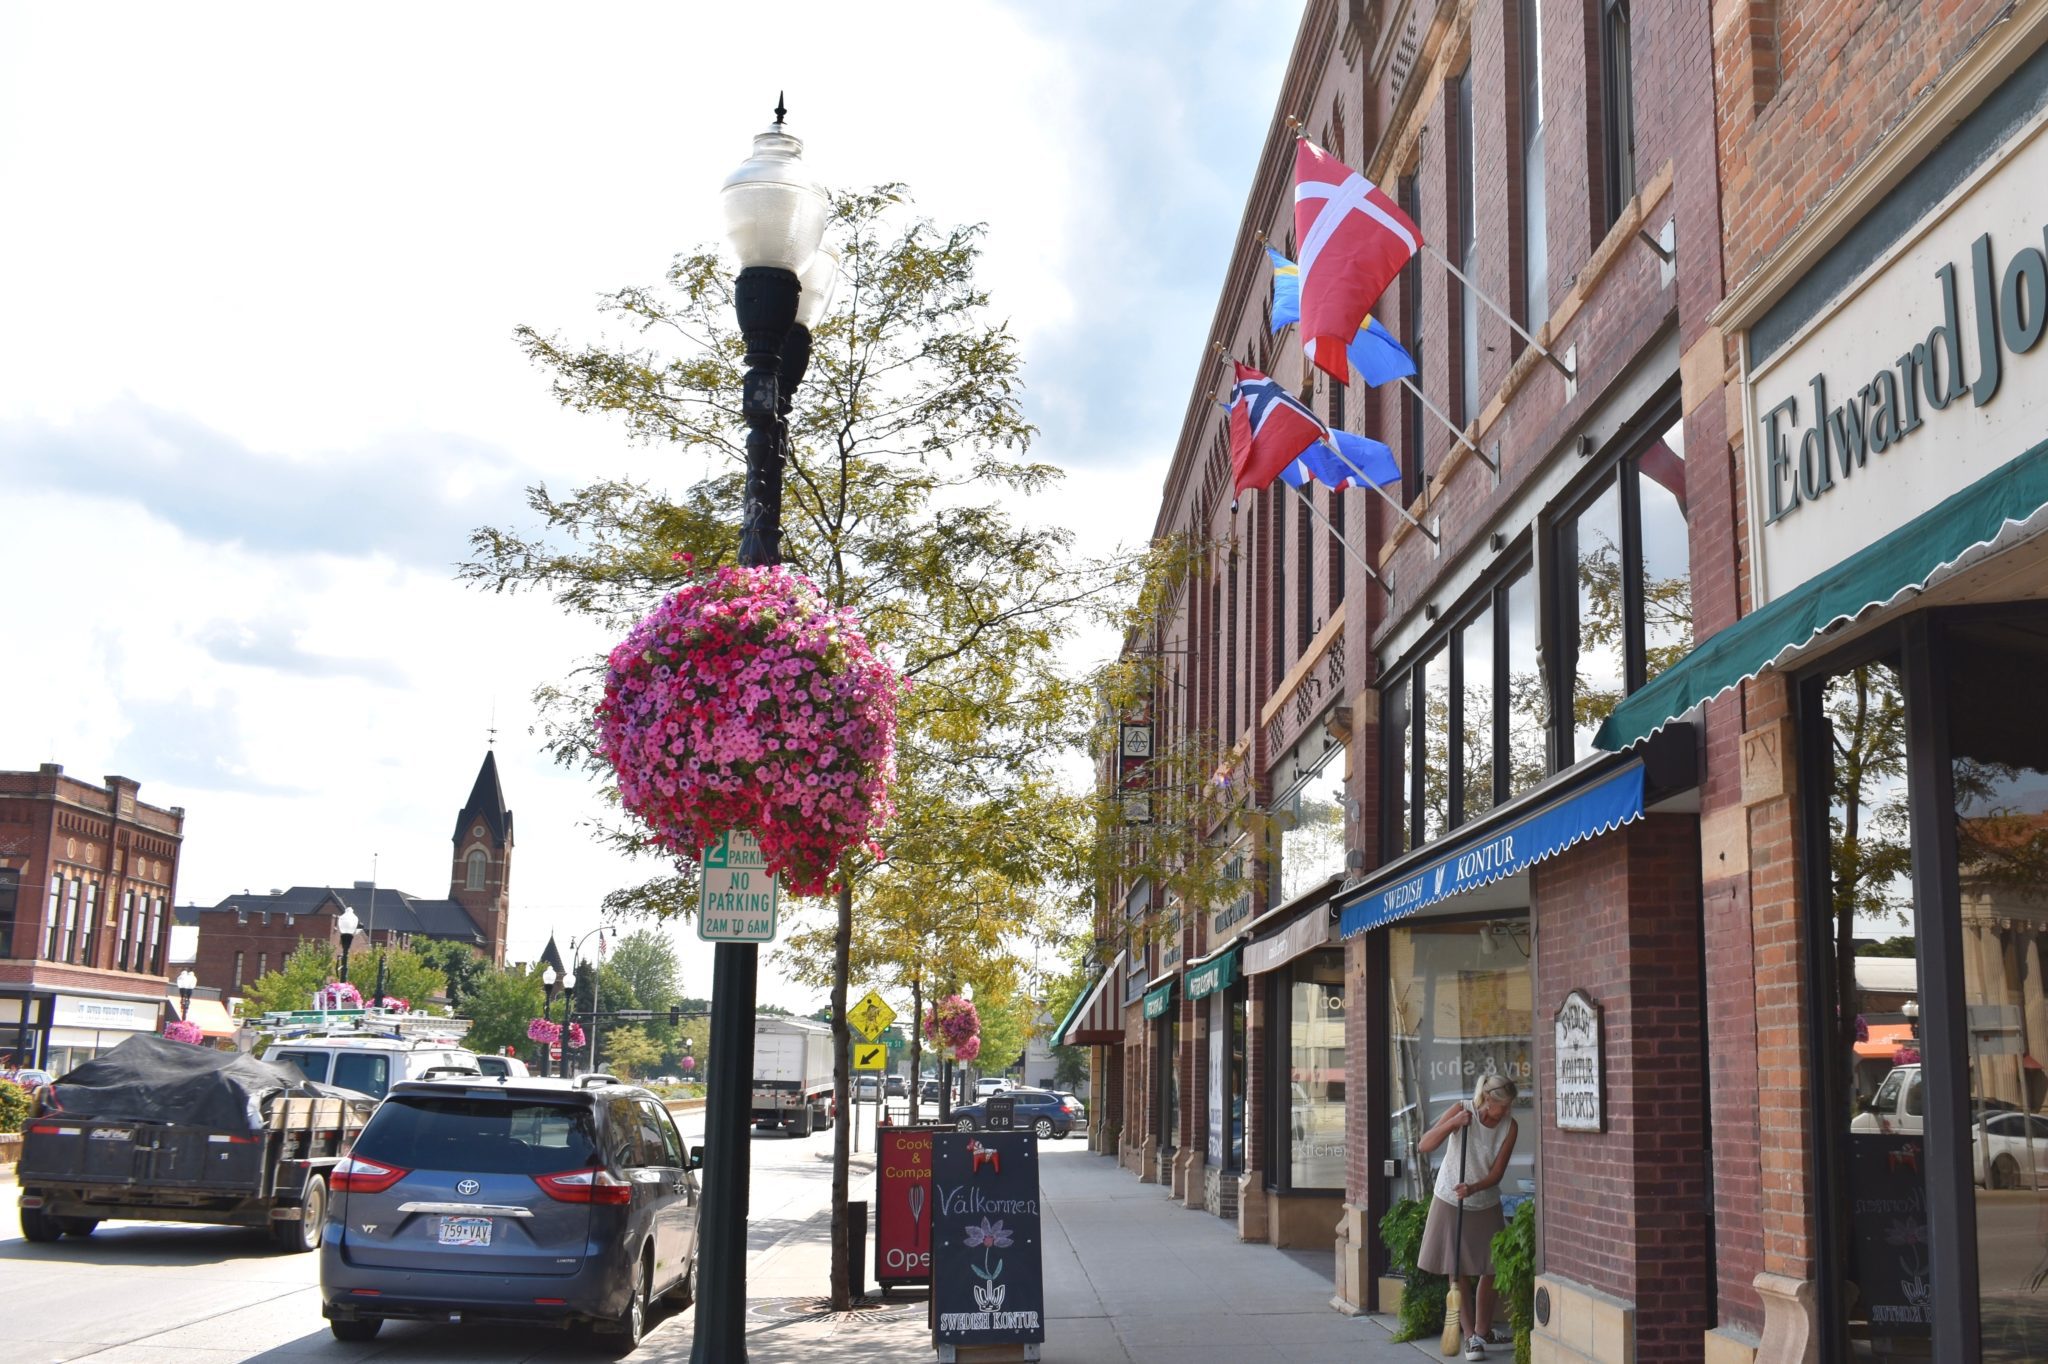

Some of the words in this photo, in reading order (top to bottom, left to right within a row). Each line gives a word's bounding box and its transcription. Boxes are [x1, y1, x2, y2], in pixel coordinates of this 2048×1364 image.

[1761, 224, 2048, 527] EdwardJo
[731, 872, 750, 890] NO
[1383, 877, 1424, 913] SWEDISH
[1456, 835, 1515, 882] KONTUR
[708, 892, 769, 912] PARKING
[706, 918, 728, 933] 2AM
[732, 918, 744, 933] TO
[747, 919, 769, 934] 6AM
[1561, 1005, 1591, 1041] SWEDISH
[1561, 1058, 1594, 1085] KONTUR
[1560, 1092, 1594, 1119] IMPORTS
[912, 1152, 921, 1164] &
[362, 1224, 377, 1233] VT
[444, 1224, 462, 1239] 759
[470, 1225, 489, 1240] VAV
[940, 1312, 991, 1331] SWEDISH
[993, 1310, 1040, 1330] KONTUR
